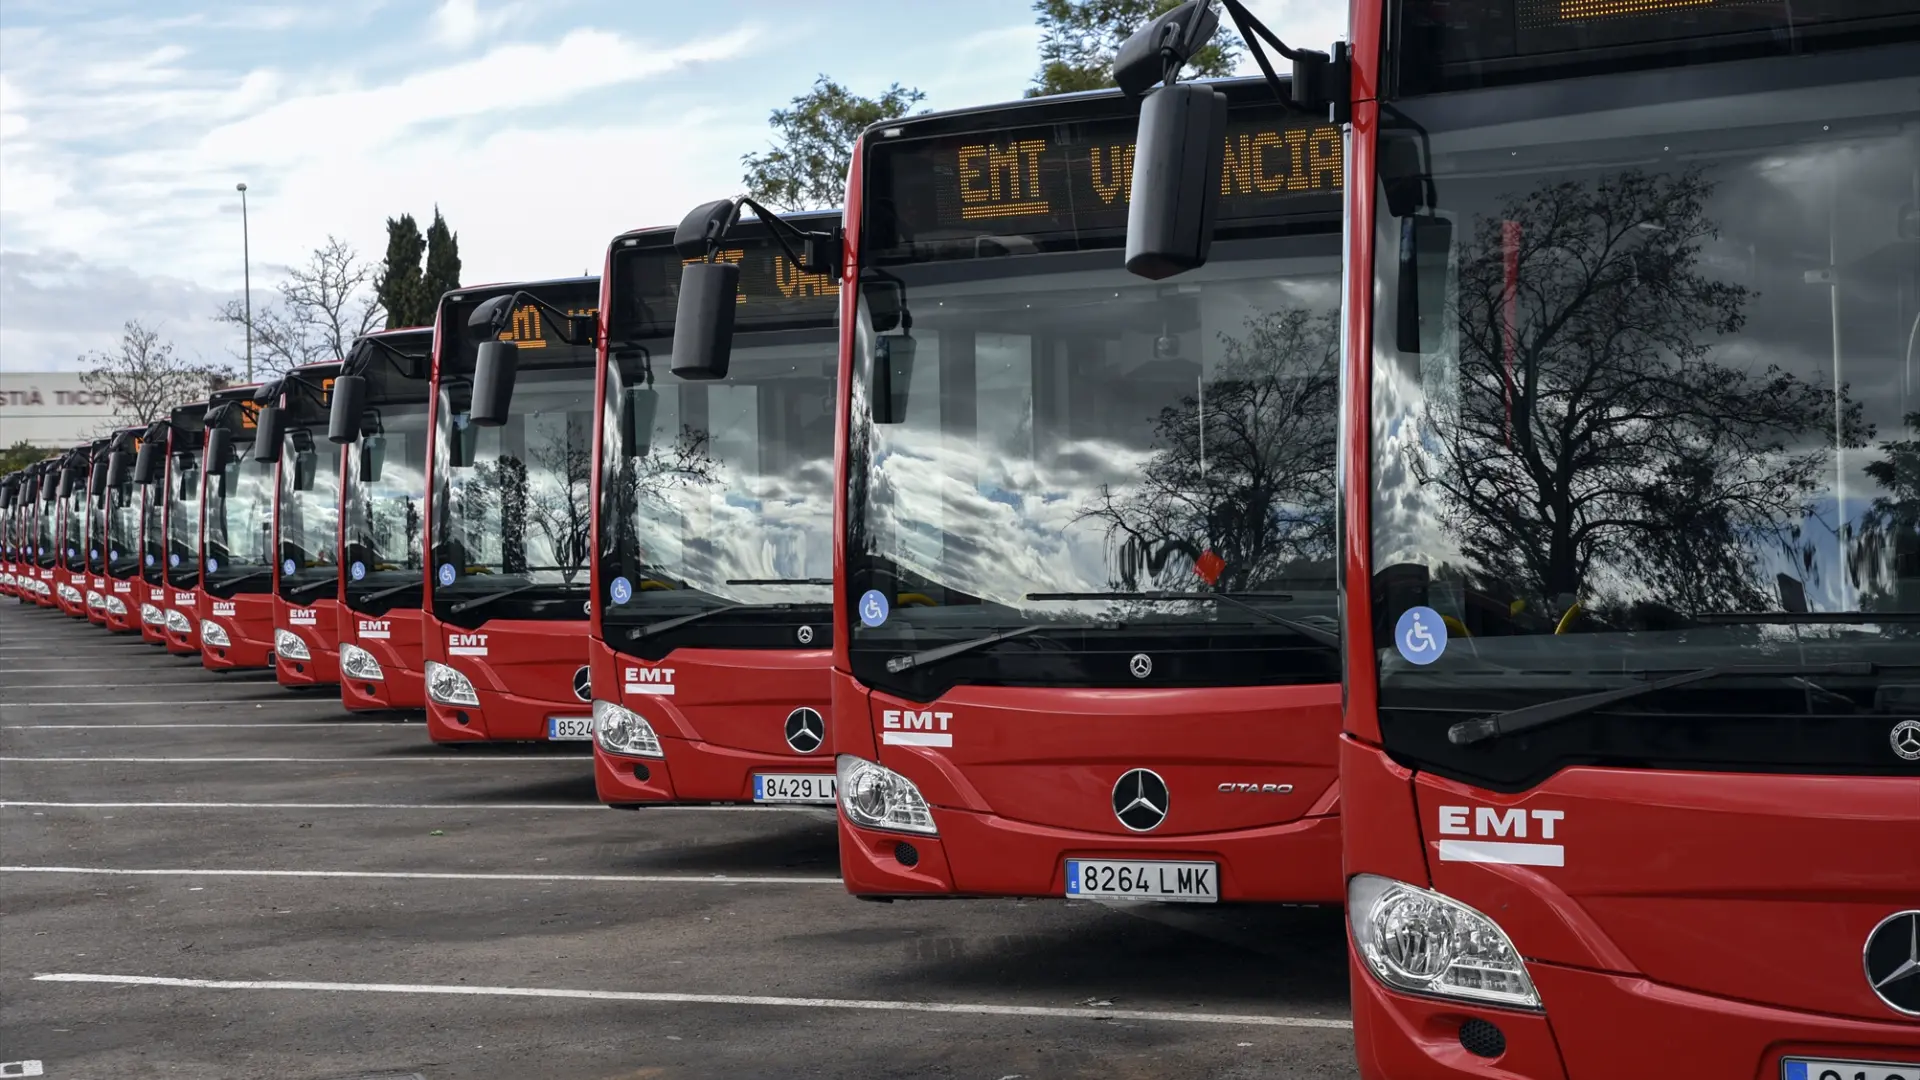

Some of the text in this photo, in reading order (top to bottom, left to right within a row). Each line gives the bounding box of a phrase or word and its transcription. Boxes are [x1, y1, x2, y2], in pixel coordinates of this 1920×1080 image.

[959, 127, 1343, 204] EMT VNCIA
[213, 602, 236, 610] EMT
[290, 609, 317, 618] EMT
[358, 621, 391, 631] EMT
[449, 634, 489, 646] EMT
[625, 667, 675, 683] EMT
[558, 720, 593, 736] 8524
[883, 710, 954, 731] EMT
[766, 778, 812, 798] 8429
[1217, 783, 1294, 793] CITARO
[1439, 806, 1565, 839] EMT
[1084, 865, 1211, 895] 8264 LMK
